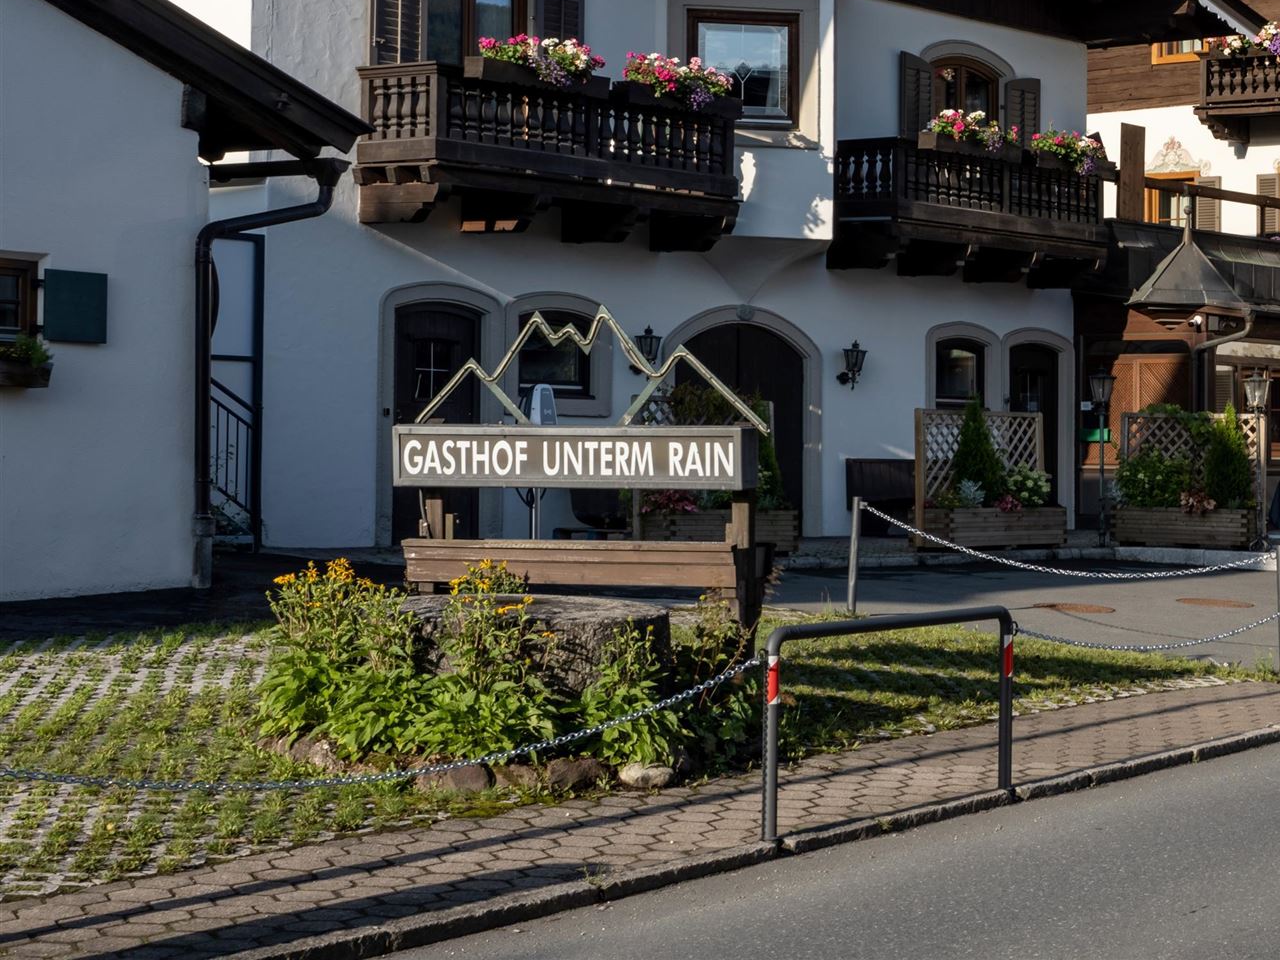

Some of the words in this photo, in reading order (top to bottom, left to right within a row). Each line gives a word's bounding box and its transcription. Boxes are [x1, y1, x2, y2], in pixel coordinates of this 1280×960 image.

[403, 440, 528, 476] GASTHOF
[543, 441, 654, 477] UNTERM
[669, 442, 734, 477] RAIN
